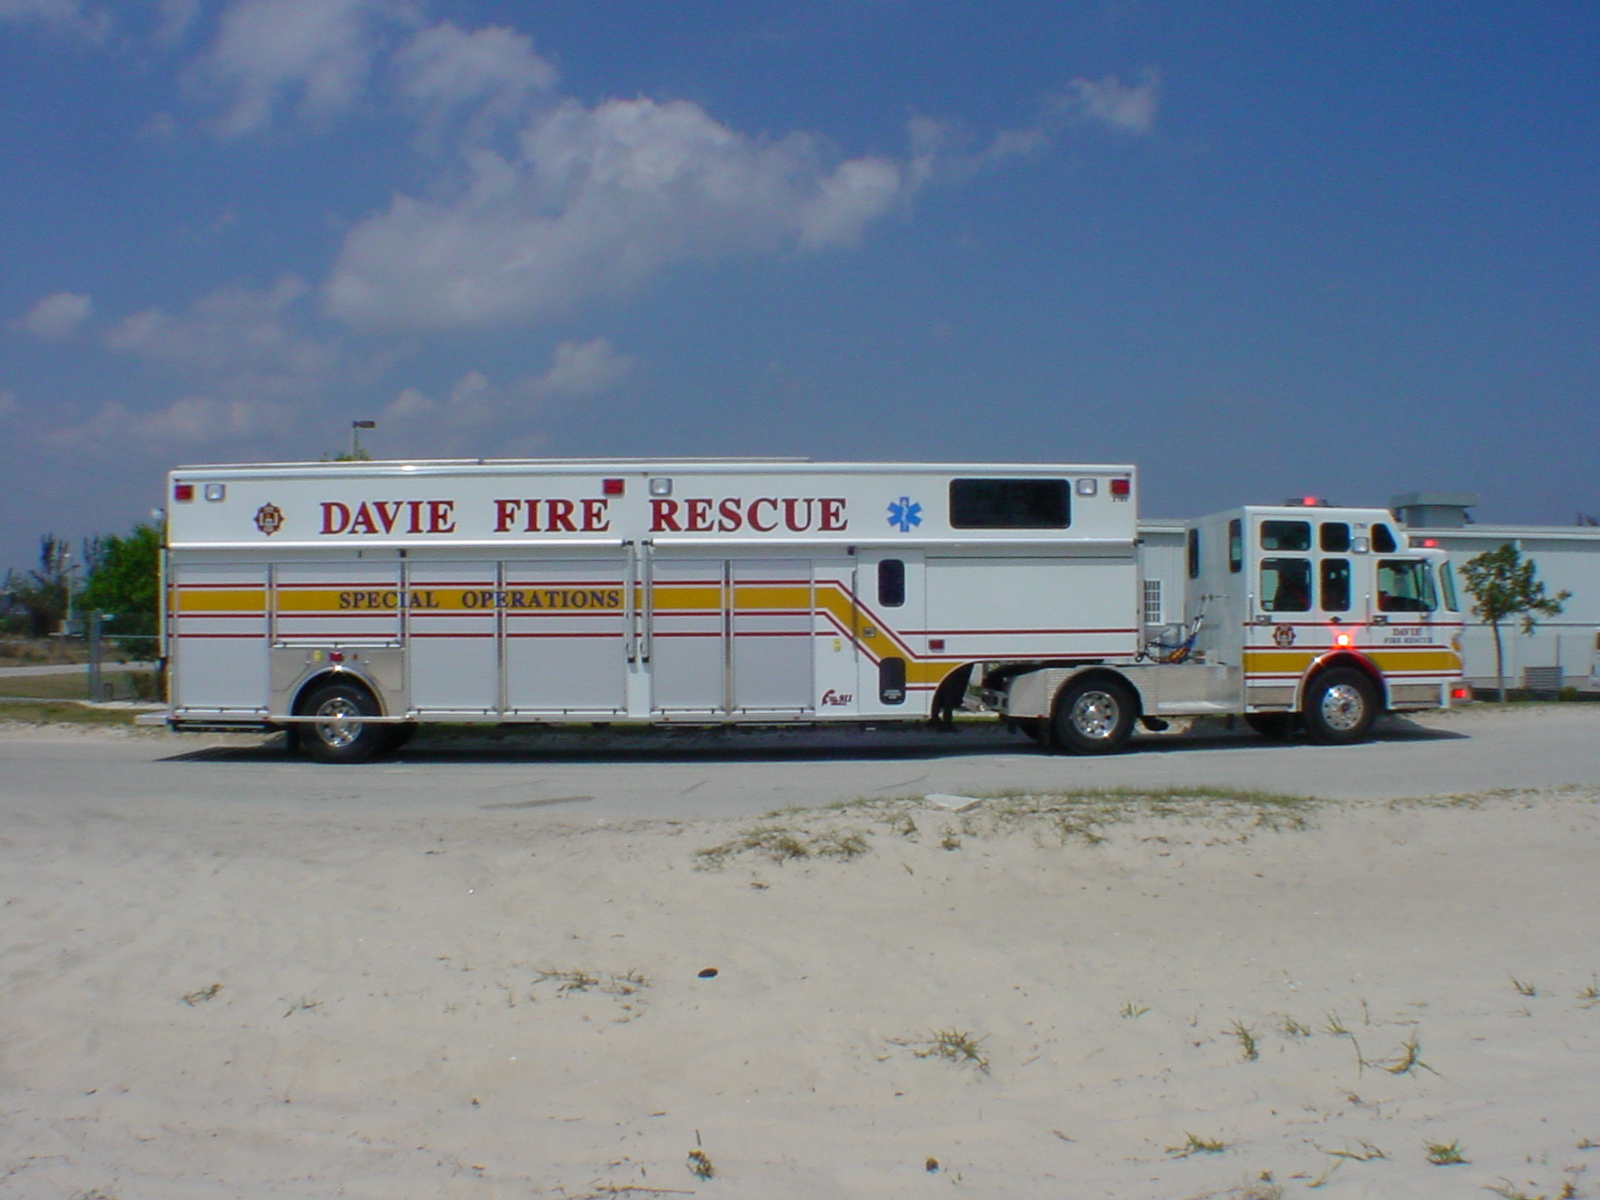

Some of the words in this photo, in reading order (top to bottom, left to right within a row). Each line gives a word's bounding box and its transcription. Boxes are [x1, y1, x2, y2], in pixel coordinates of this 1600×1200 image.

[320, 500, 456, 535] DAVIE
[493, 499, 611, 533] FIRE
[649, 497, 849, 533] RESCUE
[338, 590, 439, 608] SPECIAL
[462, 590, 620, 607] OPERATIONS
[1392, 628, 1422, 636] DAVIE
